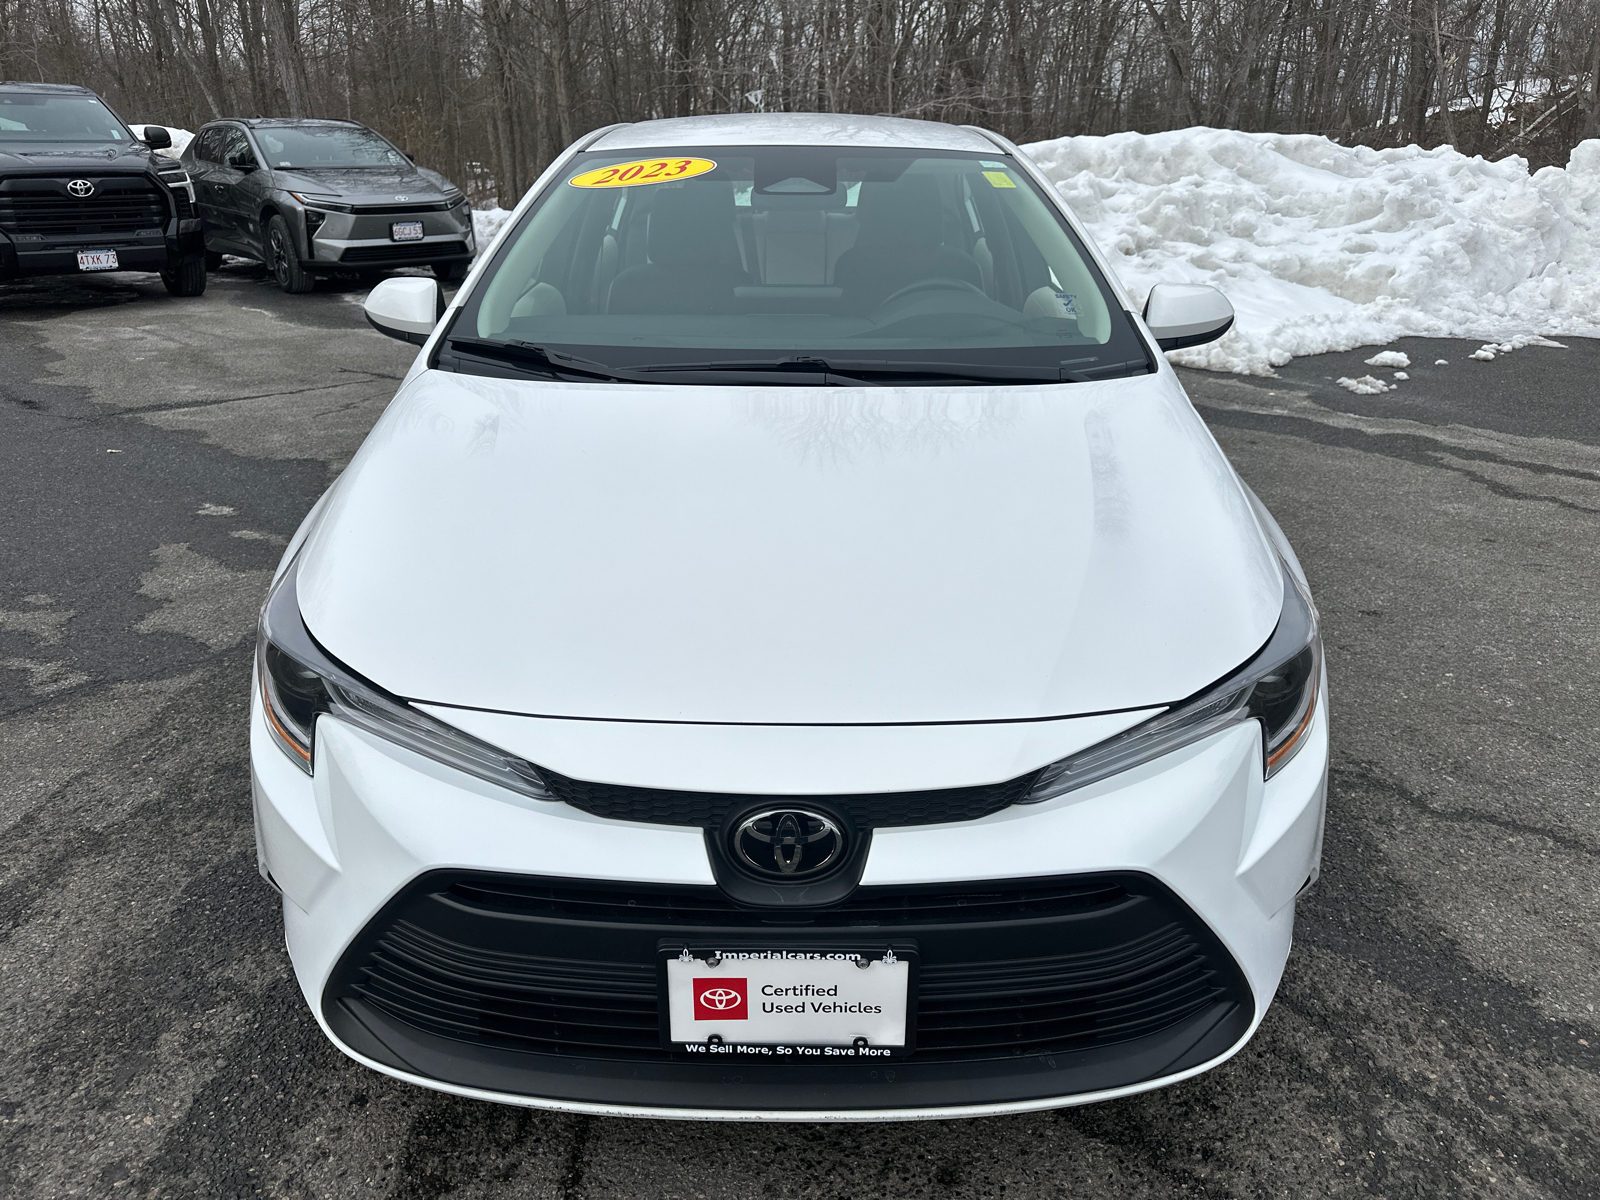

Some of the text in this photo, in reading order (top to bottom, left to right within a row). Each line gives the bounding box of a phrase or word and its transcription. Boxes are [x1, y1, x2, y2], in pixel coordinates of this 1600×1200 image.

[592, 160, 692, 185] 2023
[80, 254, 117, 265] 4TXK 73
[714, 951, 861, 961] Imperialcars.com
[761, 984, 838, 997] Certified
[762, 1002, 882, 1014] Used Vehicles
[685, 1044, 891, 1056] We Sell More, So You Save More
